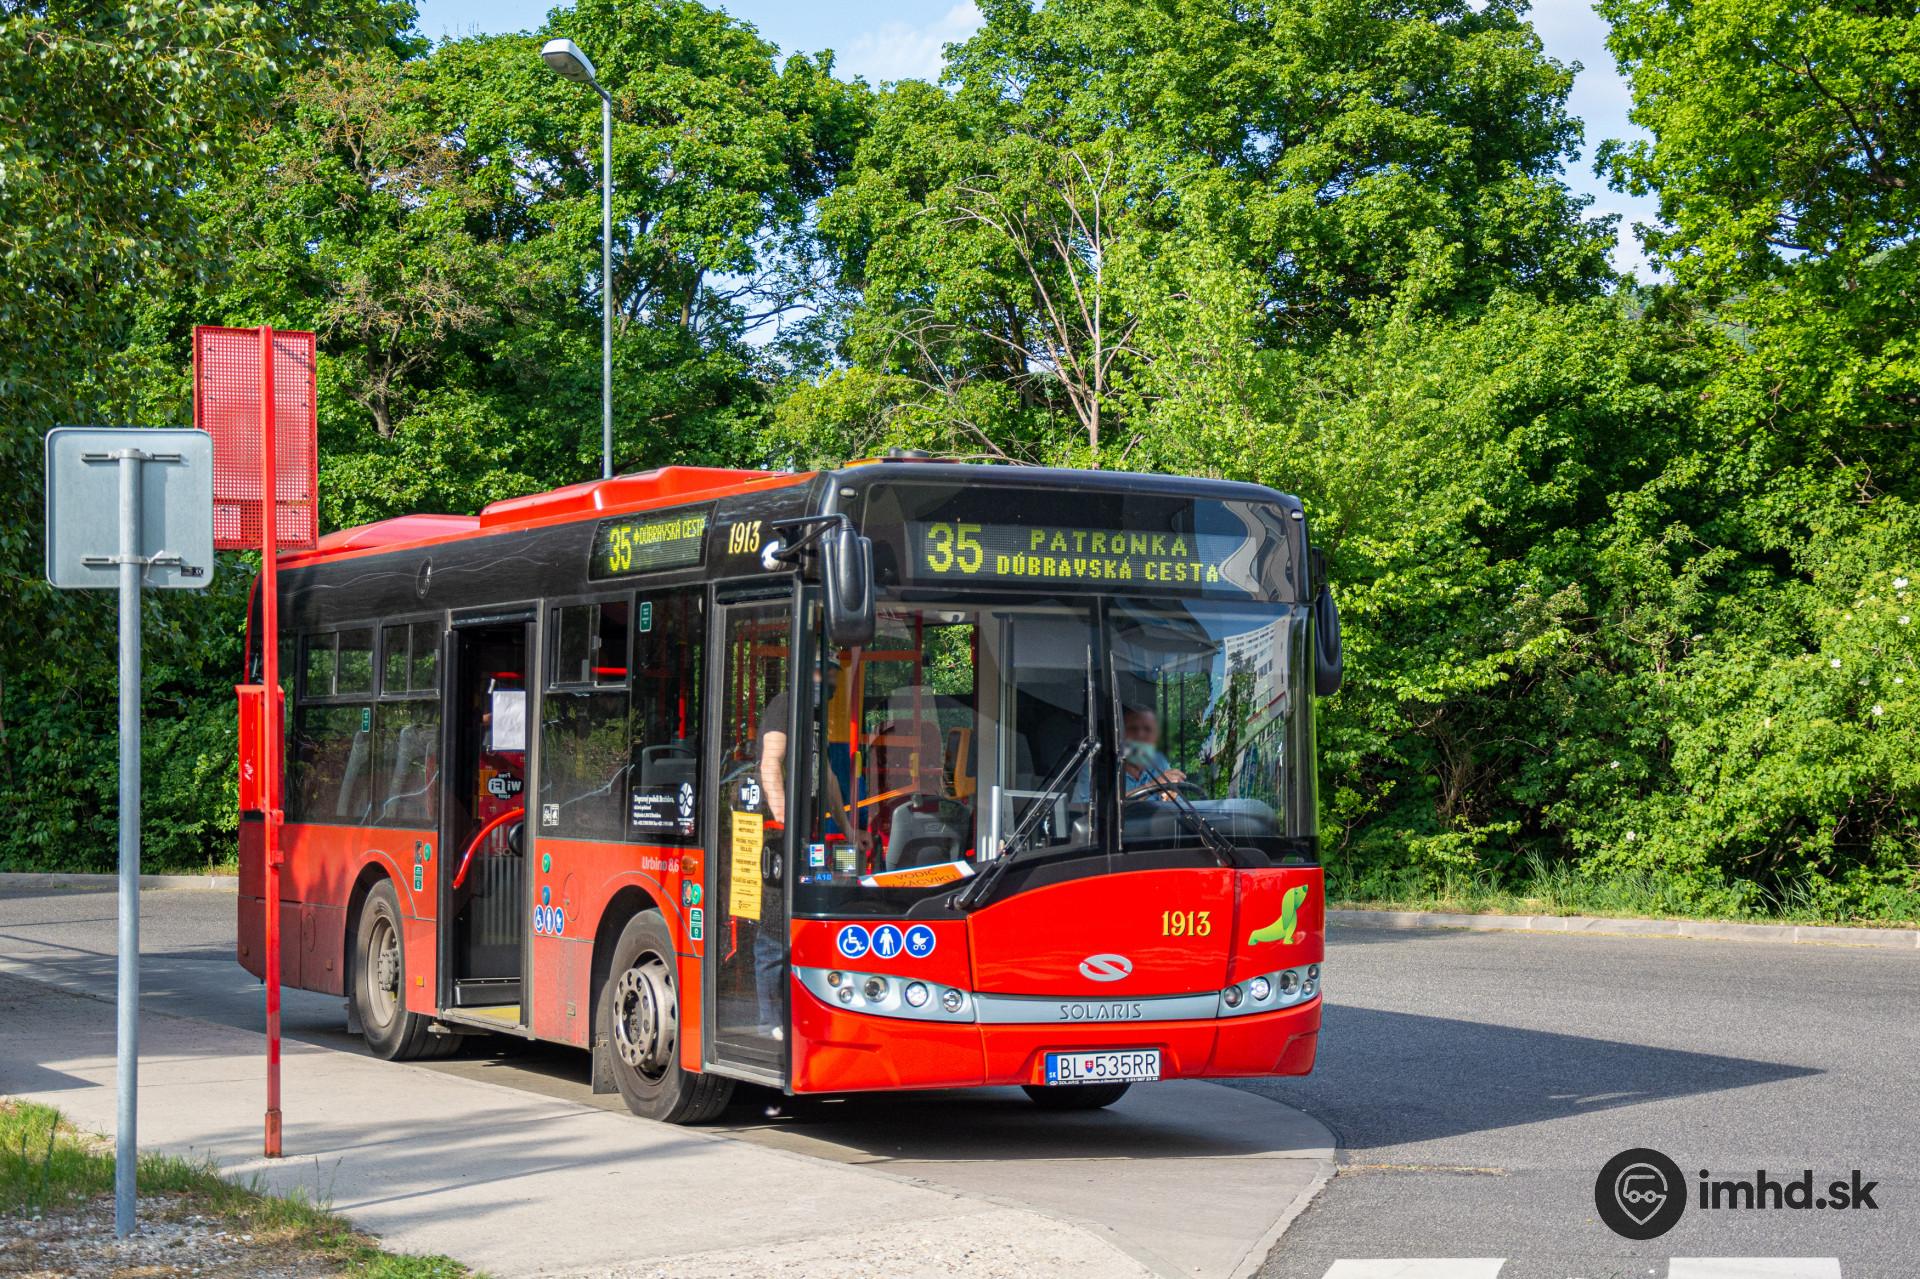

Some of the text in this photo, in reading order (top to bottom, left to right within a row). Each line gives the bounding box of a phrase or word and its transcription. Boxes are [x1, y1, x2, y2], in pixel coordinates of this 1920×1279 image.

[609, 527, 632, 572] 35
[728, 520, 762, 554] 1913
[928, 522, 984, 574] 35
[1030, 529, 1188, 557] PATRÓNKA
[996, 551, 1220, 583] DÚBRAVSKÁ CESTA
[642, 855, 668, 871] Urbino
[1161, 910, 1212, 937] 1913
[1060, 1003, 1143, 1020] SOLARIS
